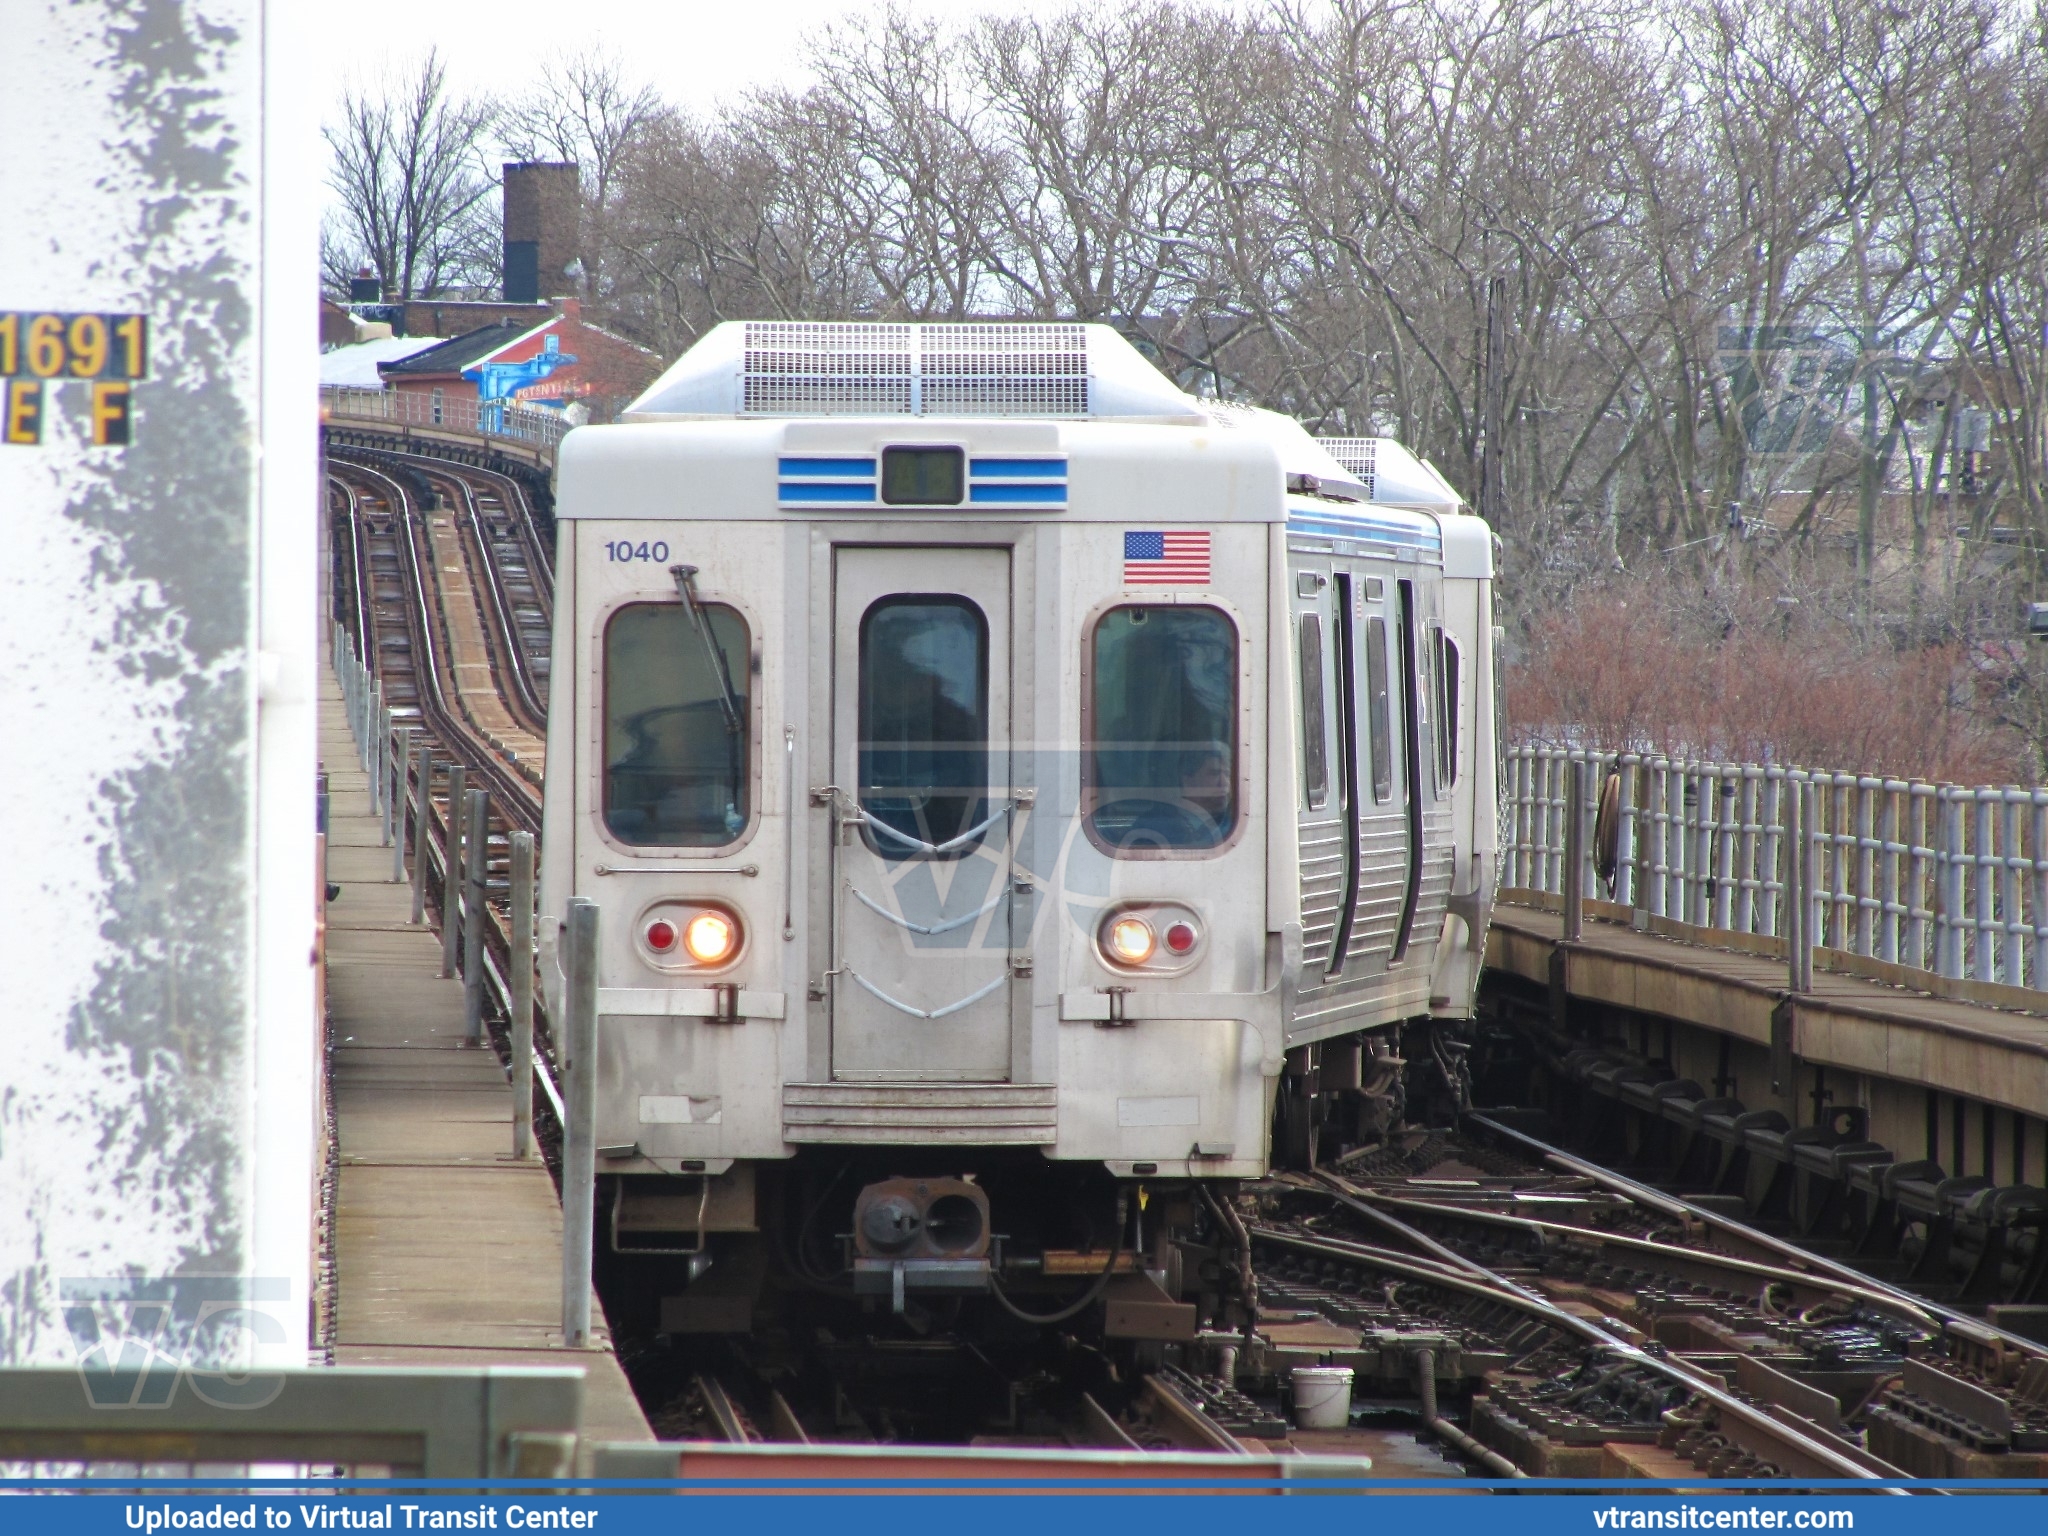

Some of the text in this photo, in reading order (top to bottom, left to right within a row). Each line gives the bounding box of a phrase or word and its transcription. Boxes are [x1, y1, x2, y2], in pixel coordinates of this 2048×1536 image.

[0, 313, 141, 377] 1691
[8, 380, 130, 444] E F
[604, 540, 669, 563] 1040
